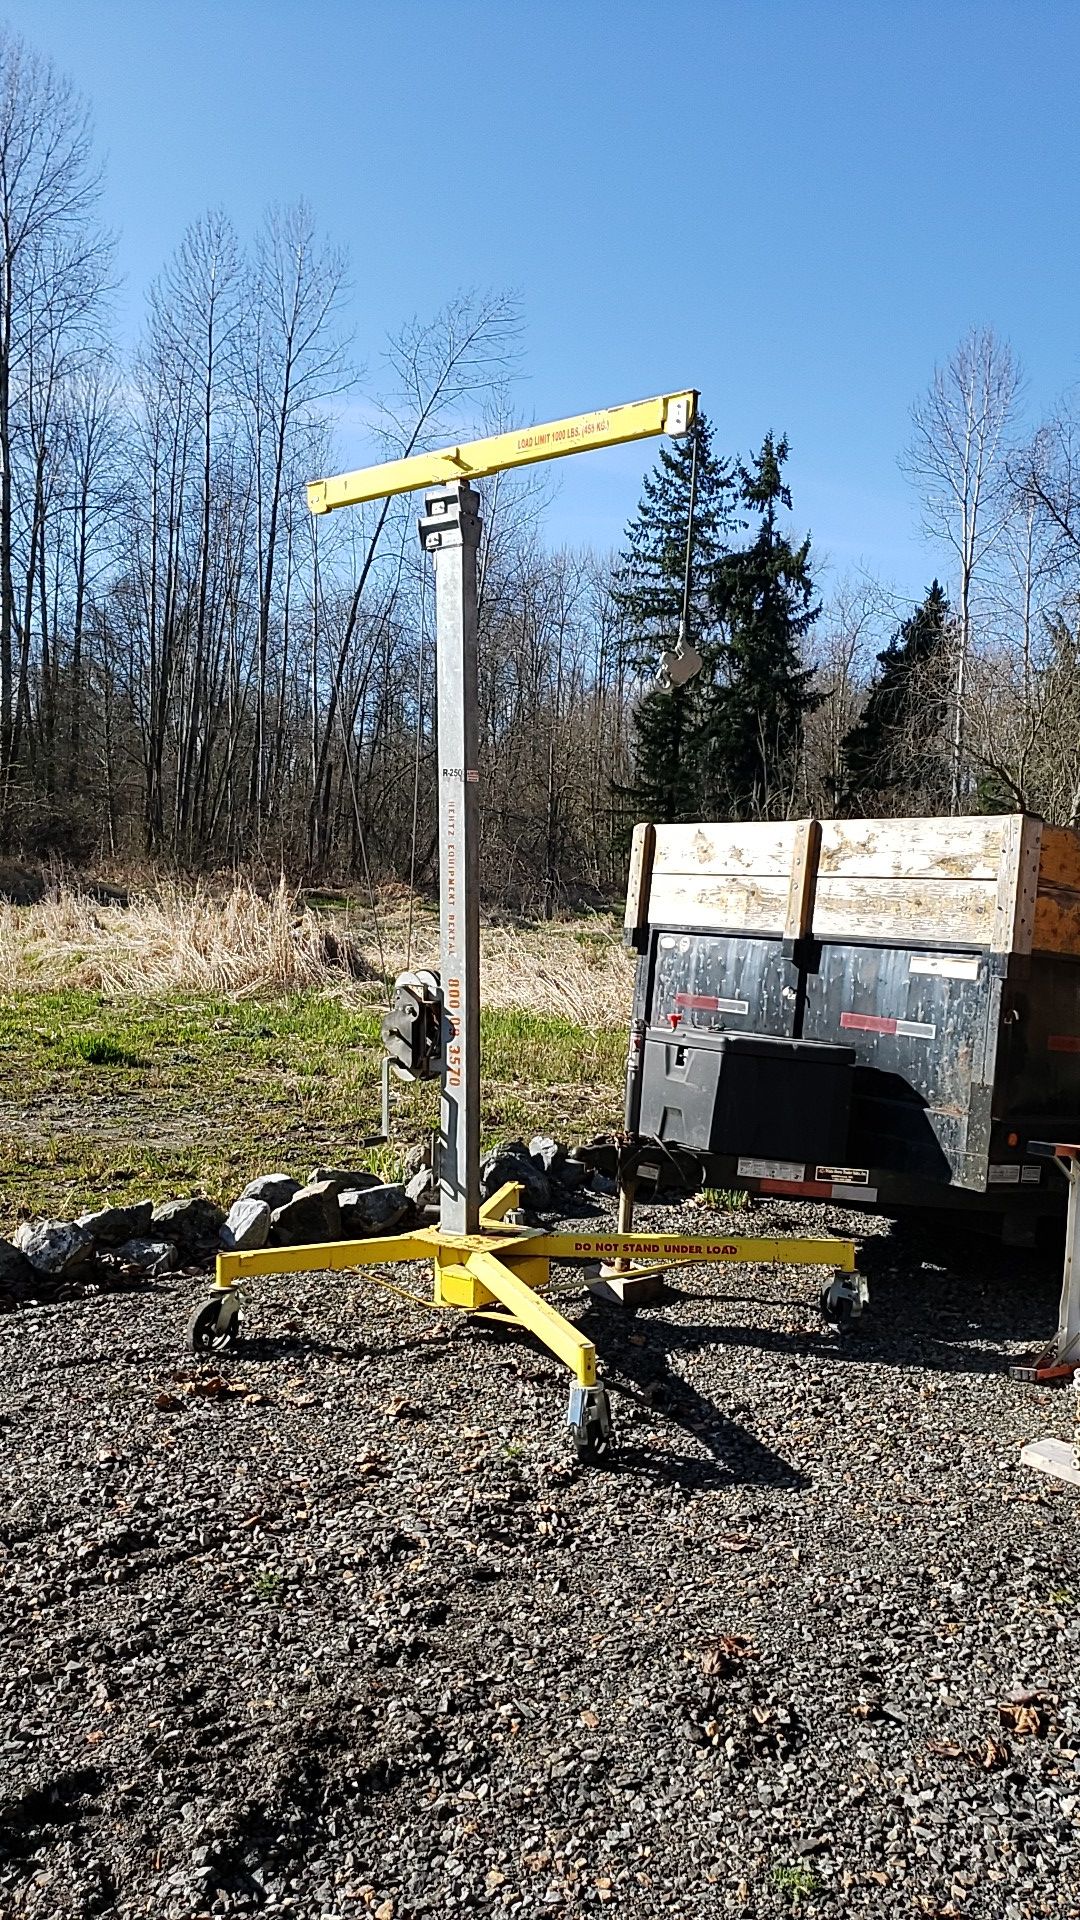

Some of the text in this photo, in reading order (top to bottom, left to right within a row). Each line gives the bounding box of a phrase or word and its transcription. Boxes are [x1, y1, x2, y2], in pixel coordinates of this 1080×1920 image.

[518, 437, 533, 449] LOAD
[534, 432, 550, 446] LIMIT
[552, 429, 566, 441] 1000
[567, 425, 580, 439] LBS.
[442, 768, 462, 777] R-250
[448, 801, 456, 955] HERTZ EQUIPMENT RENTAL
[448, 1045, 461, 1087] 3570
[574, 1242, 738, 1255] DO NOT STAND UNDER LOAD
